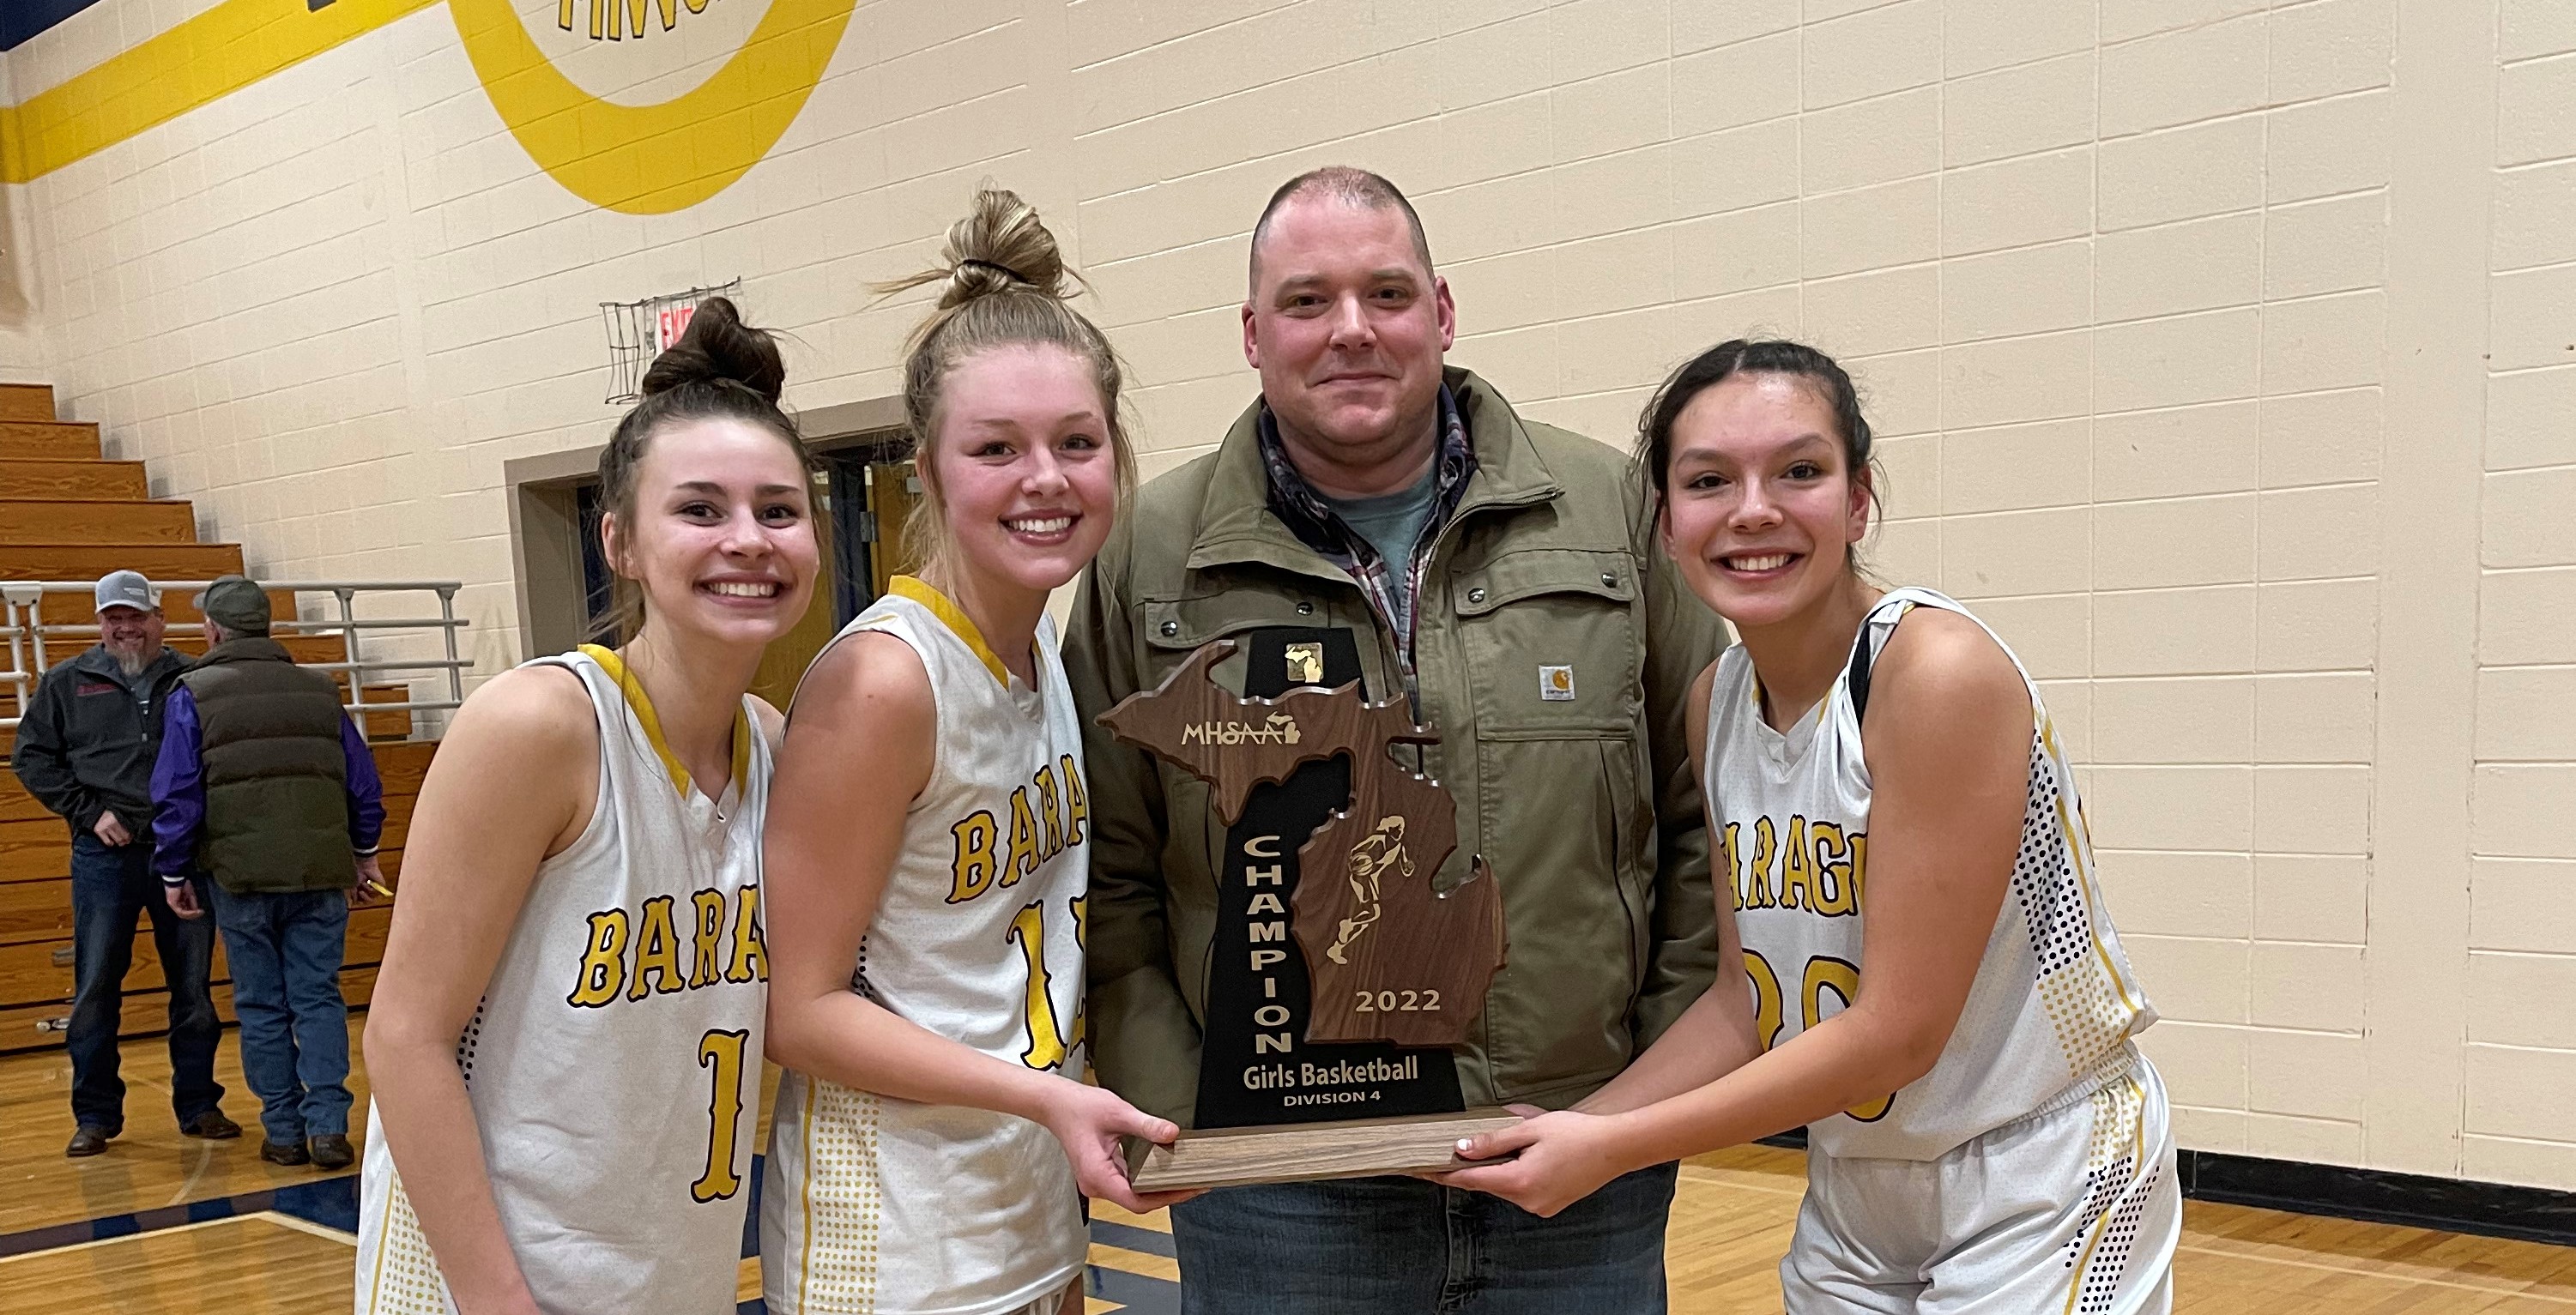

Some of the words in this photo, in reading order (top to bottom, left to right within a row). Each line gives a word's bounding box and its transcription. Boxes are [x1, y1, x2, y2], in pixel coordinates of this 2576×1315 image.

[1181, 721, 1284, 745] MHSAA
[1244, 835, 1292, 1054] CHAMPION
[1355, 989, 1441, 1012] 2022
[1243, 1064, 1296, 1090] Girls
[1301, 1054, 1419, 1087] Basketball
[1283, 1091, 1366, 1107] DIVISION
[1370, 1090, 1381, 1101] 4
[691, 1028, 749, 1203] 1
